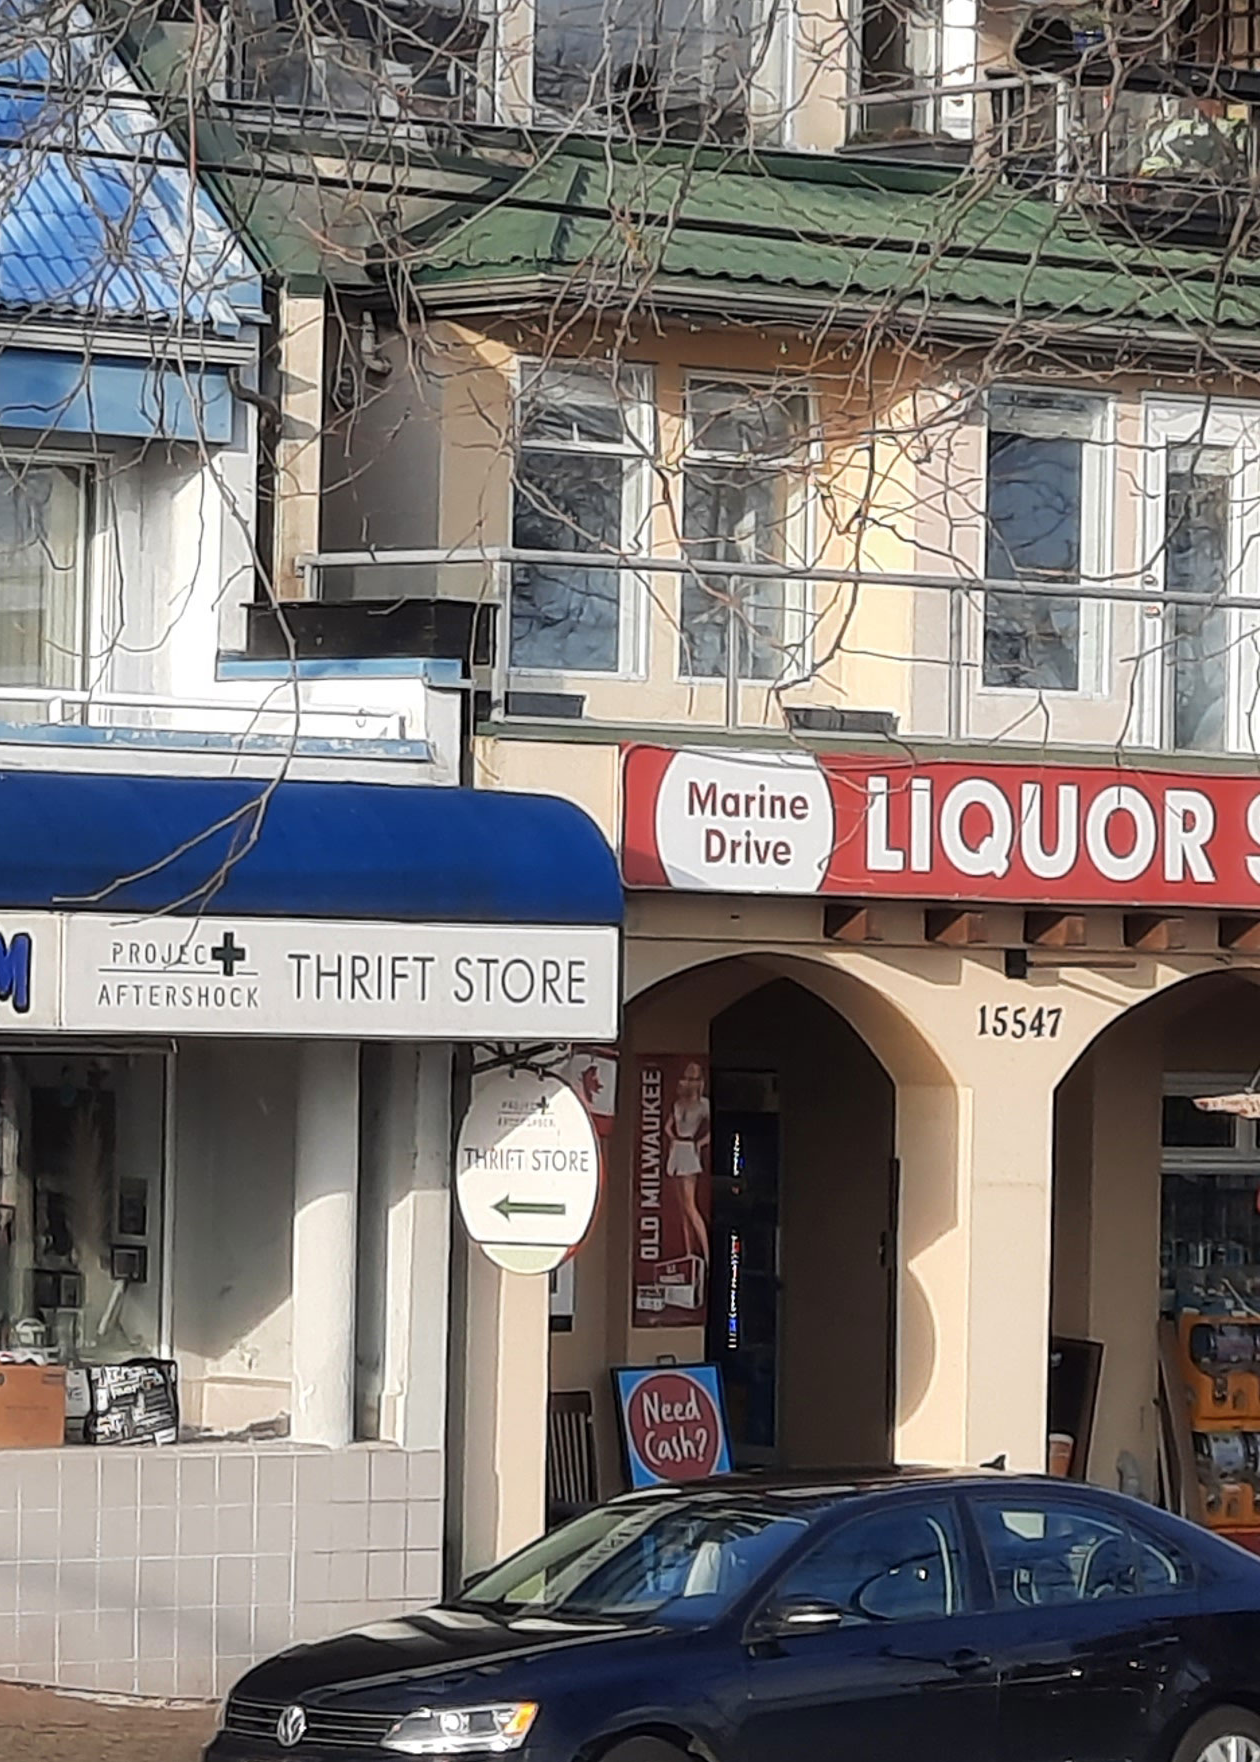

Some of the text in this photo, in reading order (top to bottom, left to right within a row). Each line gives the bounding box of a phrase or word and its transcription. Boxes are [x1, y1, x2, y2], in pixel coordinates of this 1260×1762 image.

[688, 781, 809, 821] Marine
[705, 828, 791, 865] Drive
[866, 775, 1217, 884] LIQUOR
[98, 984, 259, 1008] AFTERSHOCK
[288, 954, 586, 1004] THRIFT STORE
[978, 1004, 1063, 1039] 15547
[464, 1147, 589, 1172] THRIFT STORE
[641, 1070, 662, 1260] OLD MILWAUKEE
[642, 1386, 701, 1429] Need
[644, 1426, 708, 1466] Cash?
